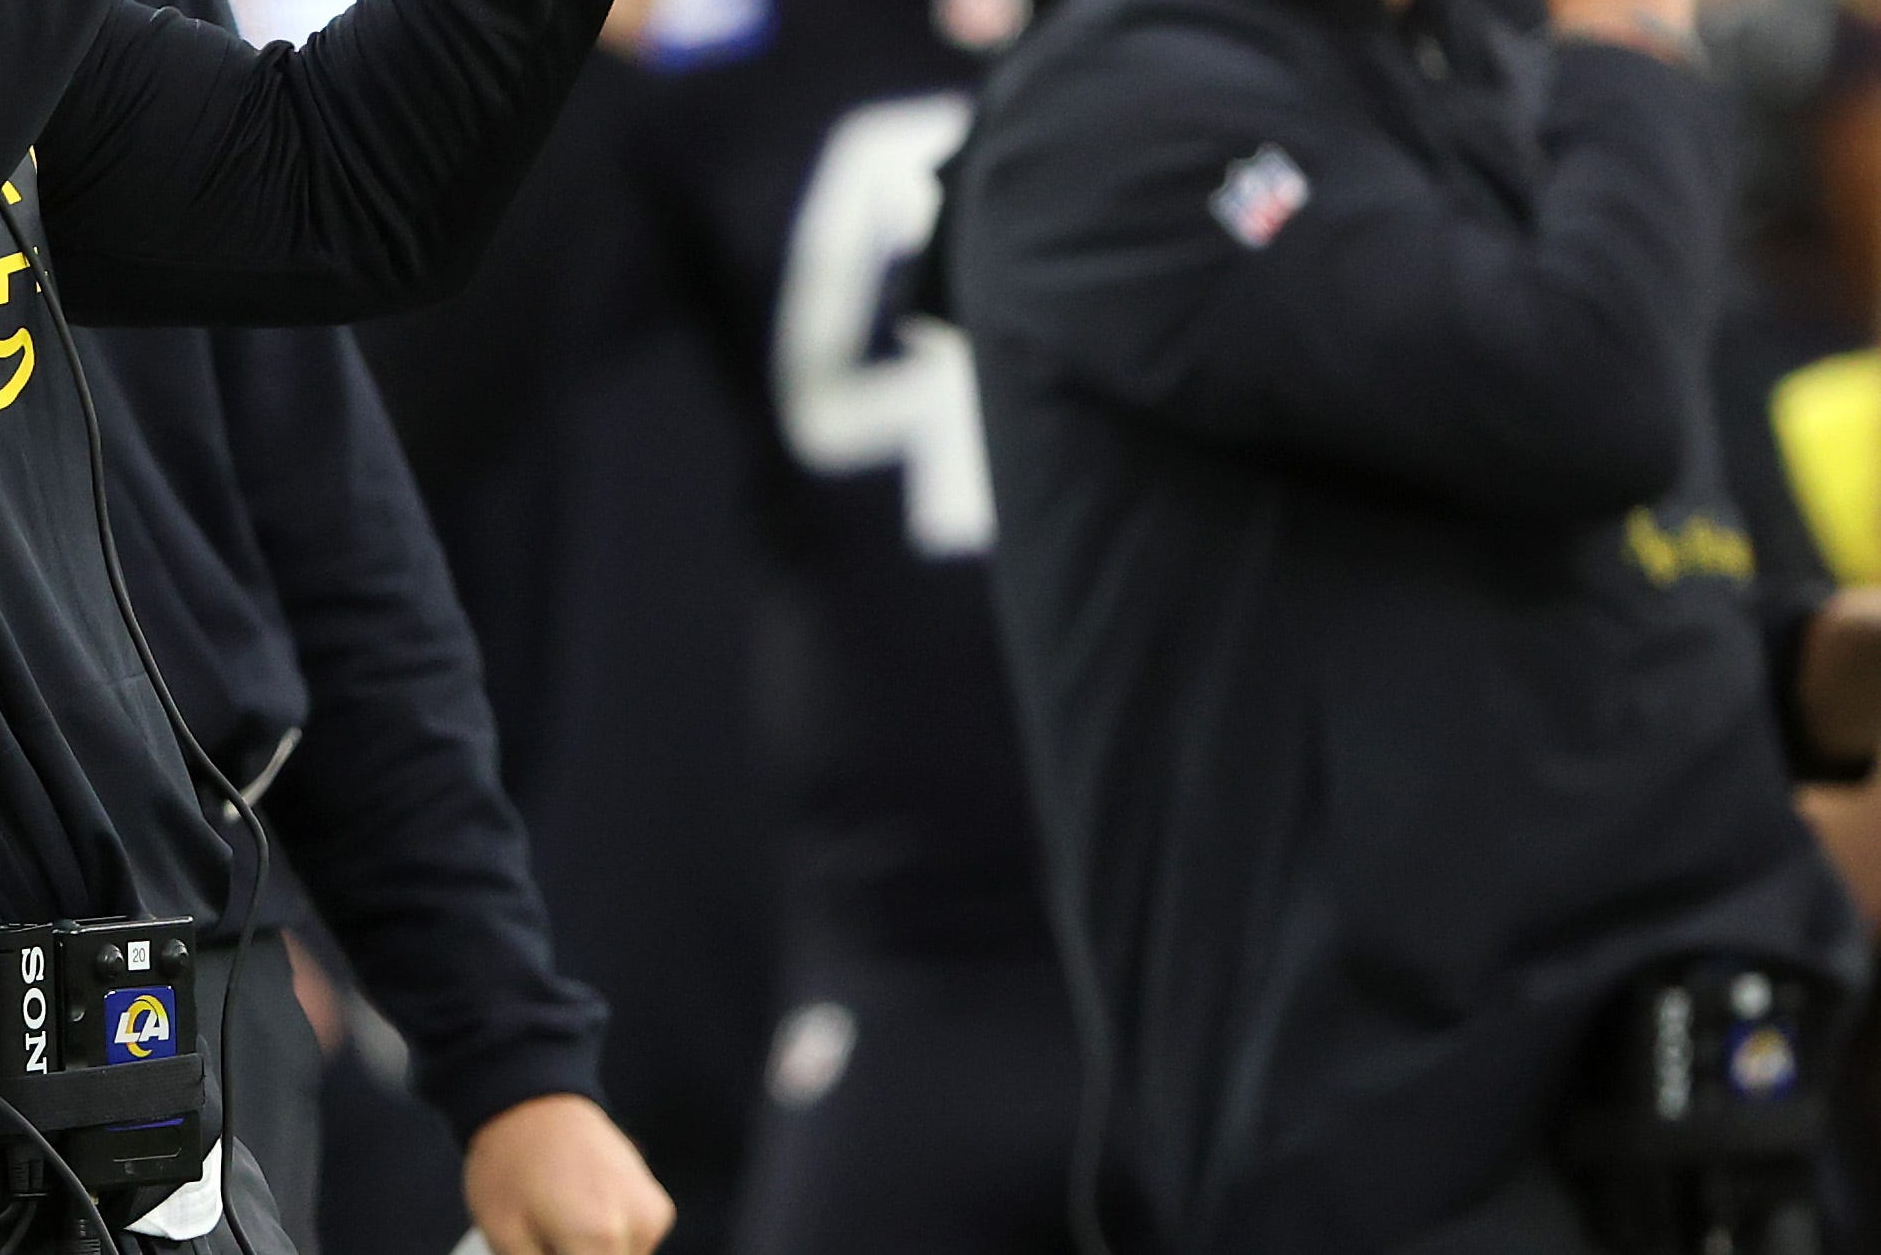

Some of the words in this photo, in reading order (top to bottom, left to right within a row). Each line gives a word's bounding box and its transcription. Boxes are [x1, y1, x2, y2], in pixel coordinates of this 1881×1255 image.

[132, 947, 146, 963] 20
[21, 946, 48, 1074] SON
[114, 998, 170, 1044] LA
